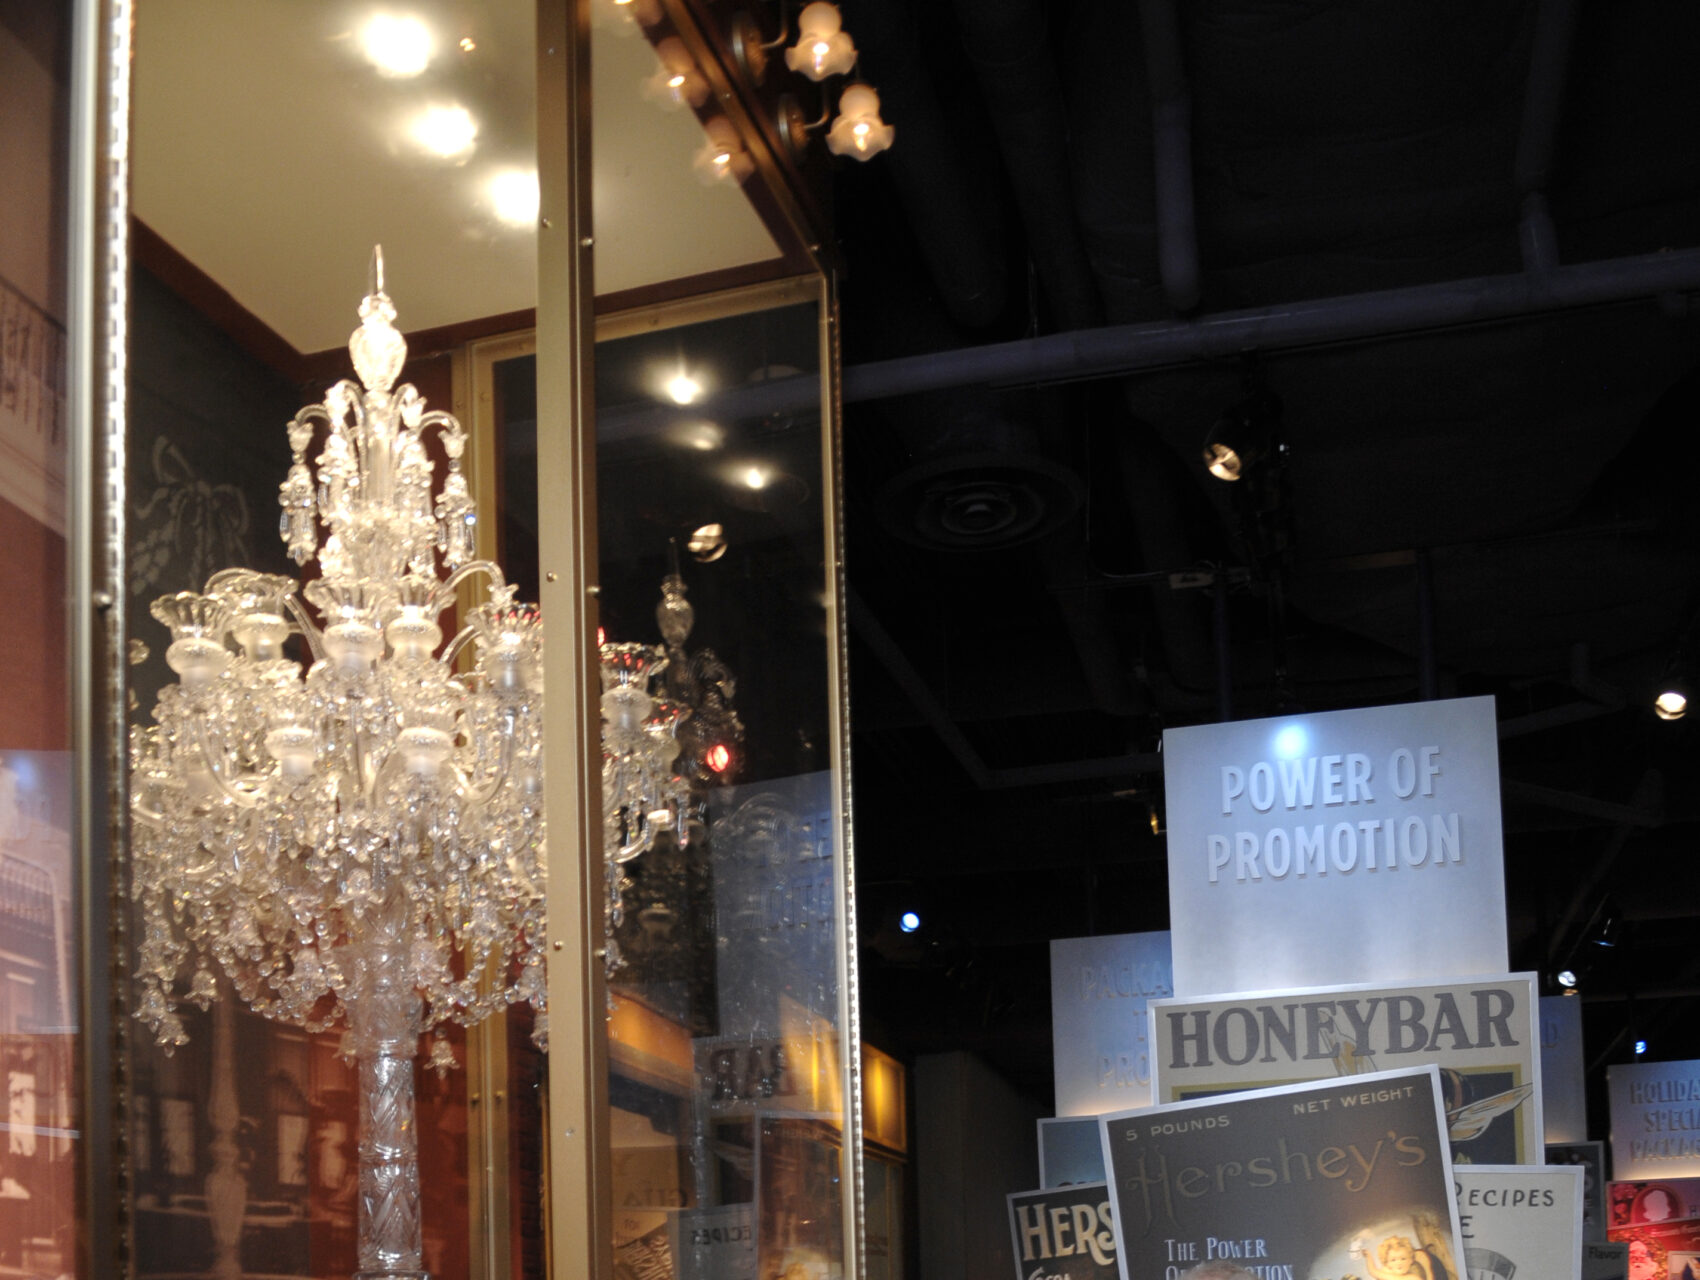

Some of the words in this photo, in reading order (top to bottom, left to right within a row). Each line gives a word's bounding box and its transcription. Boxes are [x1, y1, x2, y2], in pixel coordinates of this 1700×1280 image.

[1220, 752, 1376, 815] POWER
[1388, 745, 1442, 801] OF
[1207, 812, 1464, 884] PROMOTION
[1080, 961, 1173, 1000] PACKA
[1166, 989, 1520, 1069] HONEYBAR
[1126, 1129, 1138, 1141] 5
[1150, 1115, 1230, 1137] POUNDS
[1293, 1098, 1330, 1115] NET
[1340, 1085, 1414, 1109] WEIGHT
[1124, 1130, 1427, 1238] Hershey's
[1165, 1240, 1198, 1262] THE
[1206, 1237, 1269, 1261] POWER
